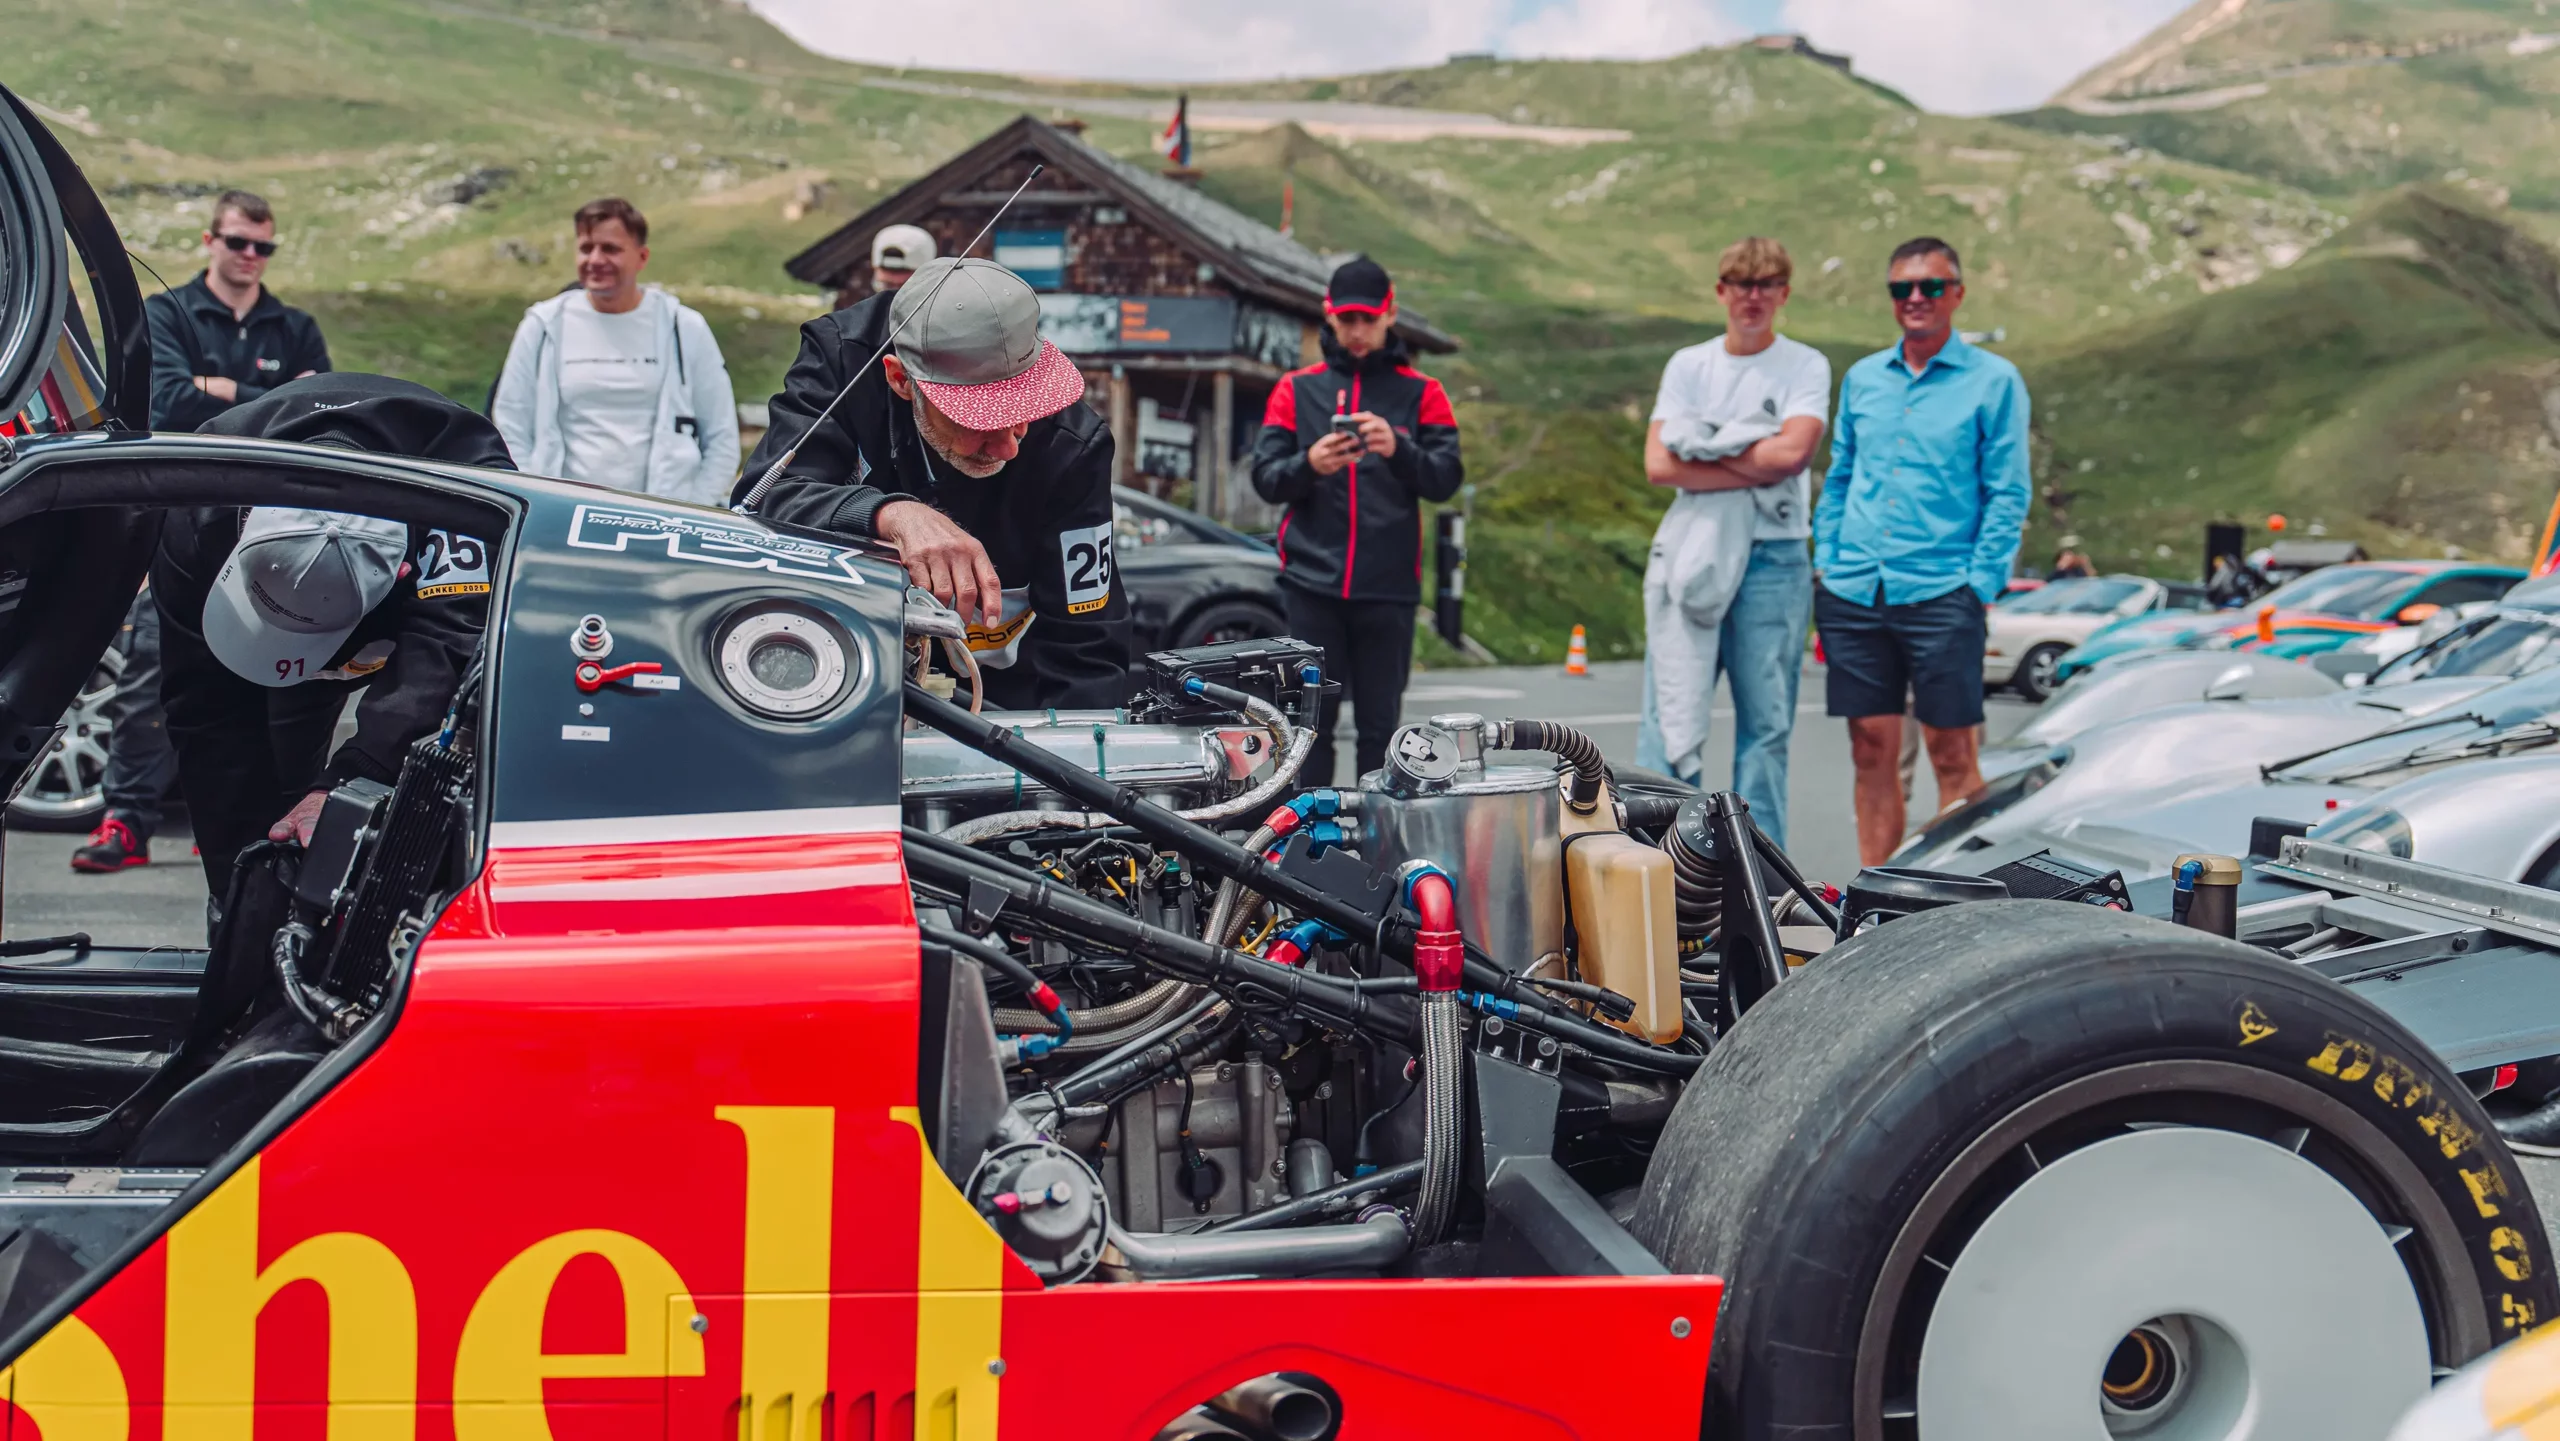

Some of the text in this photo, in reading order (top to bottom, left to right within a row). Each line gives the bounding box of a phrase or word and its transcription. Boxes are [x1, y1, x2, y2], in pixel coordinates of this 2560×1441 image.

[419, 532, 483, 580] 25
[1067, 536, 1110, 592] 25
[422, 586, 457, 598] MANKEI
[276, 658, 304, 680] 91
[1688, 802, 1714, 849] SACHS
